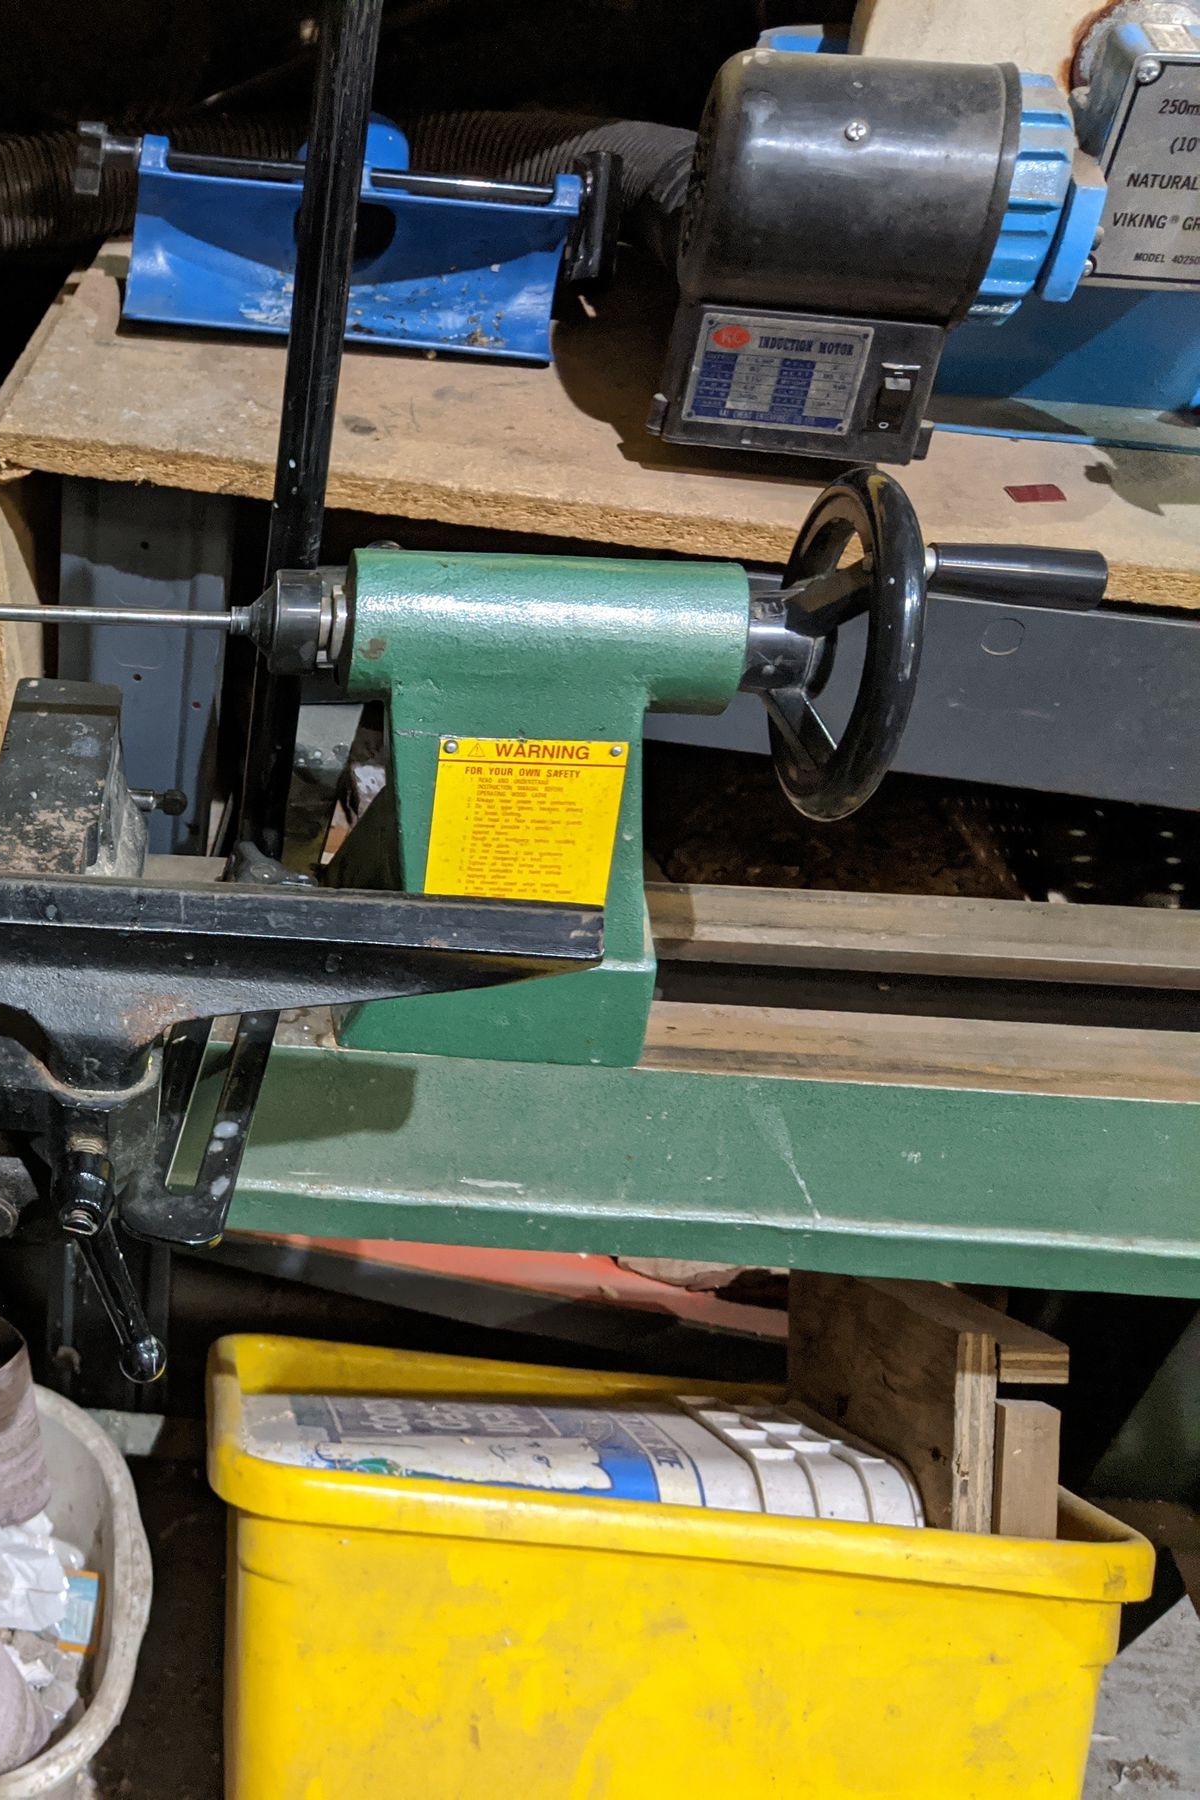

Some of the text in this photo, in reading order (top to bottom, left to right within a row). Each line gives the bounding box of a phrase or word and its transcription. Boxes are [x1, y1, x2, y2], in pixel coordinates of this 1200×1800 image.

[1126, 172, 1199, 190] NATURAL
[1133, 252, 1165, 263] MODEL
[758, 336, 854, 356] INDUCTION MOTOR
[495, 742, 590, 760] WARNING
[465, 766, 581, 778] FOR YOUR OWN SAFETY
